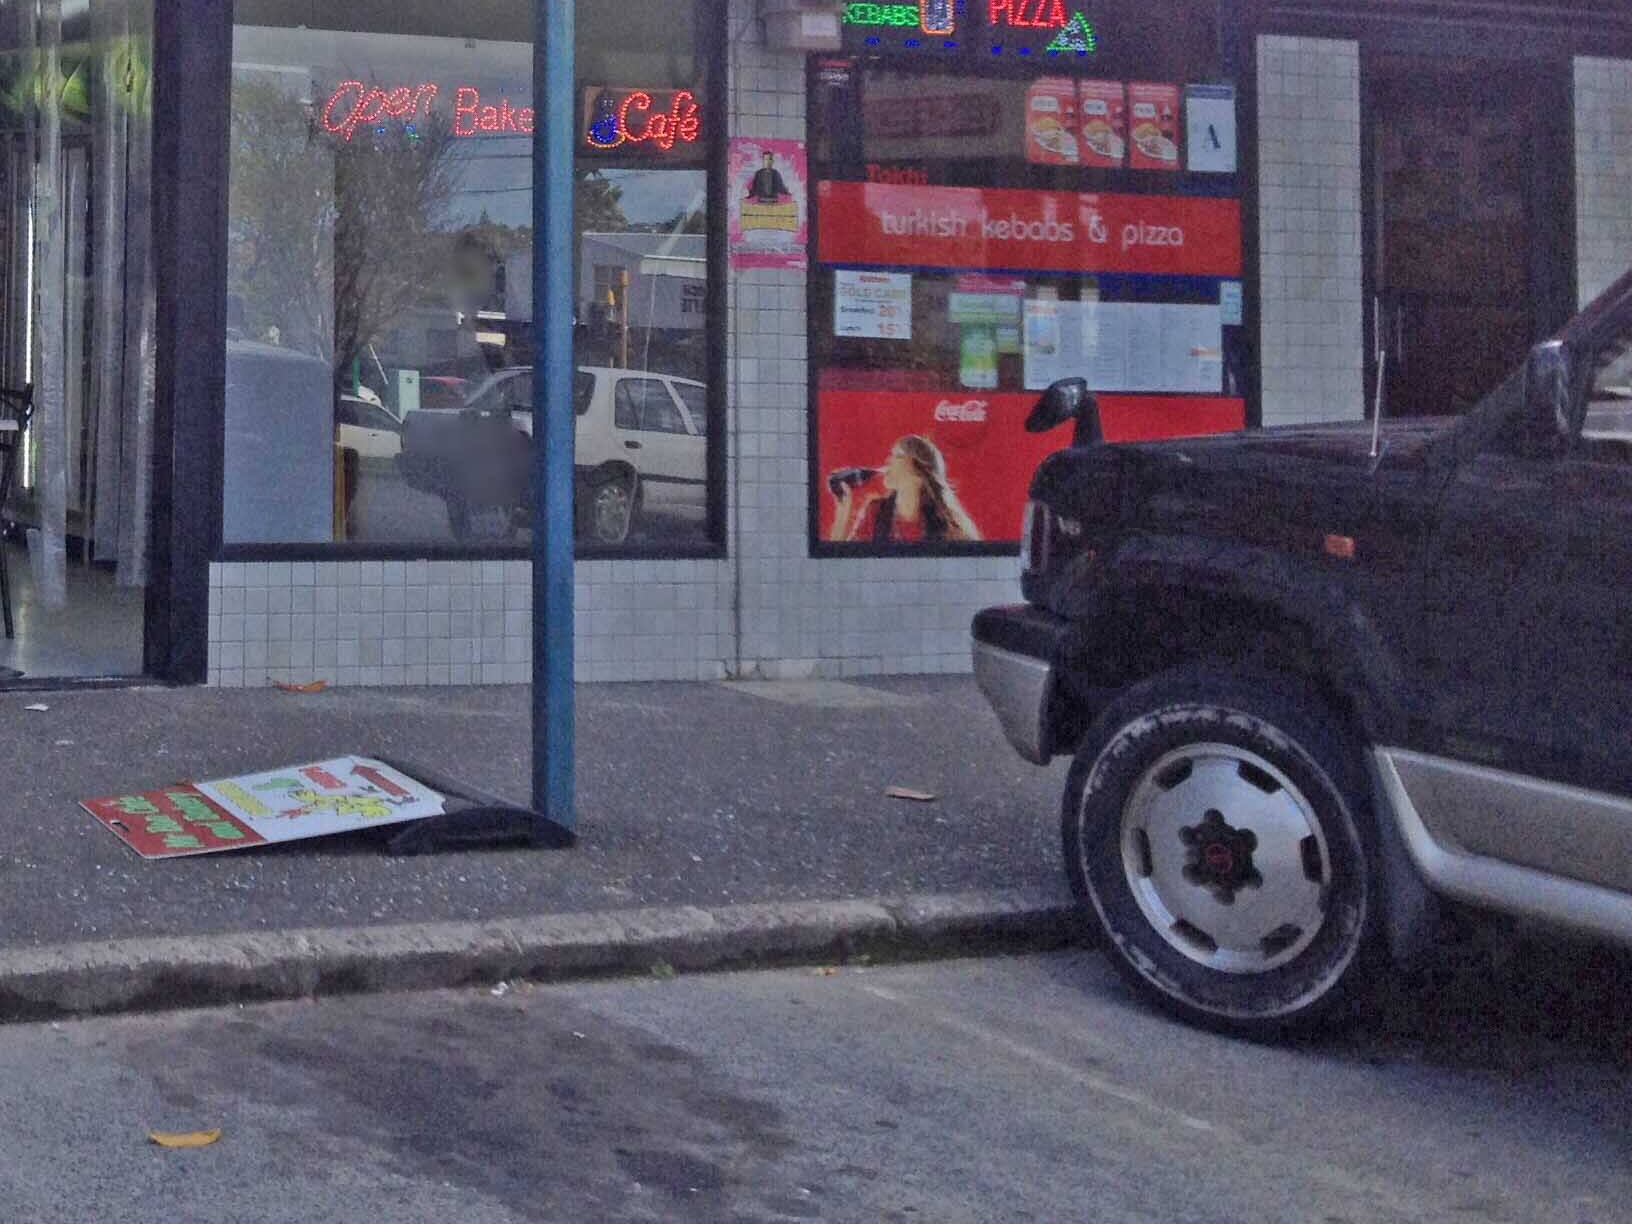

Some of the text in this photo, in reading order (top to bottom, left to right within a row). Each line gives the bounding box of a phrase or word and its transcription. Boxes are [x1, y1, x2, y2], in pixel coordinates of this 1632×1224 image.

[323, 79, 438, 142] Open
[454, 87, 534, 136] Bake
[880, 207, 967, 237] turkish
[981, 209, 1074, 242] kebabs
[1122, 220, 1184, 251] pizza
